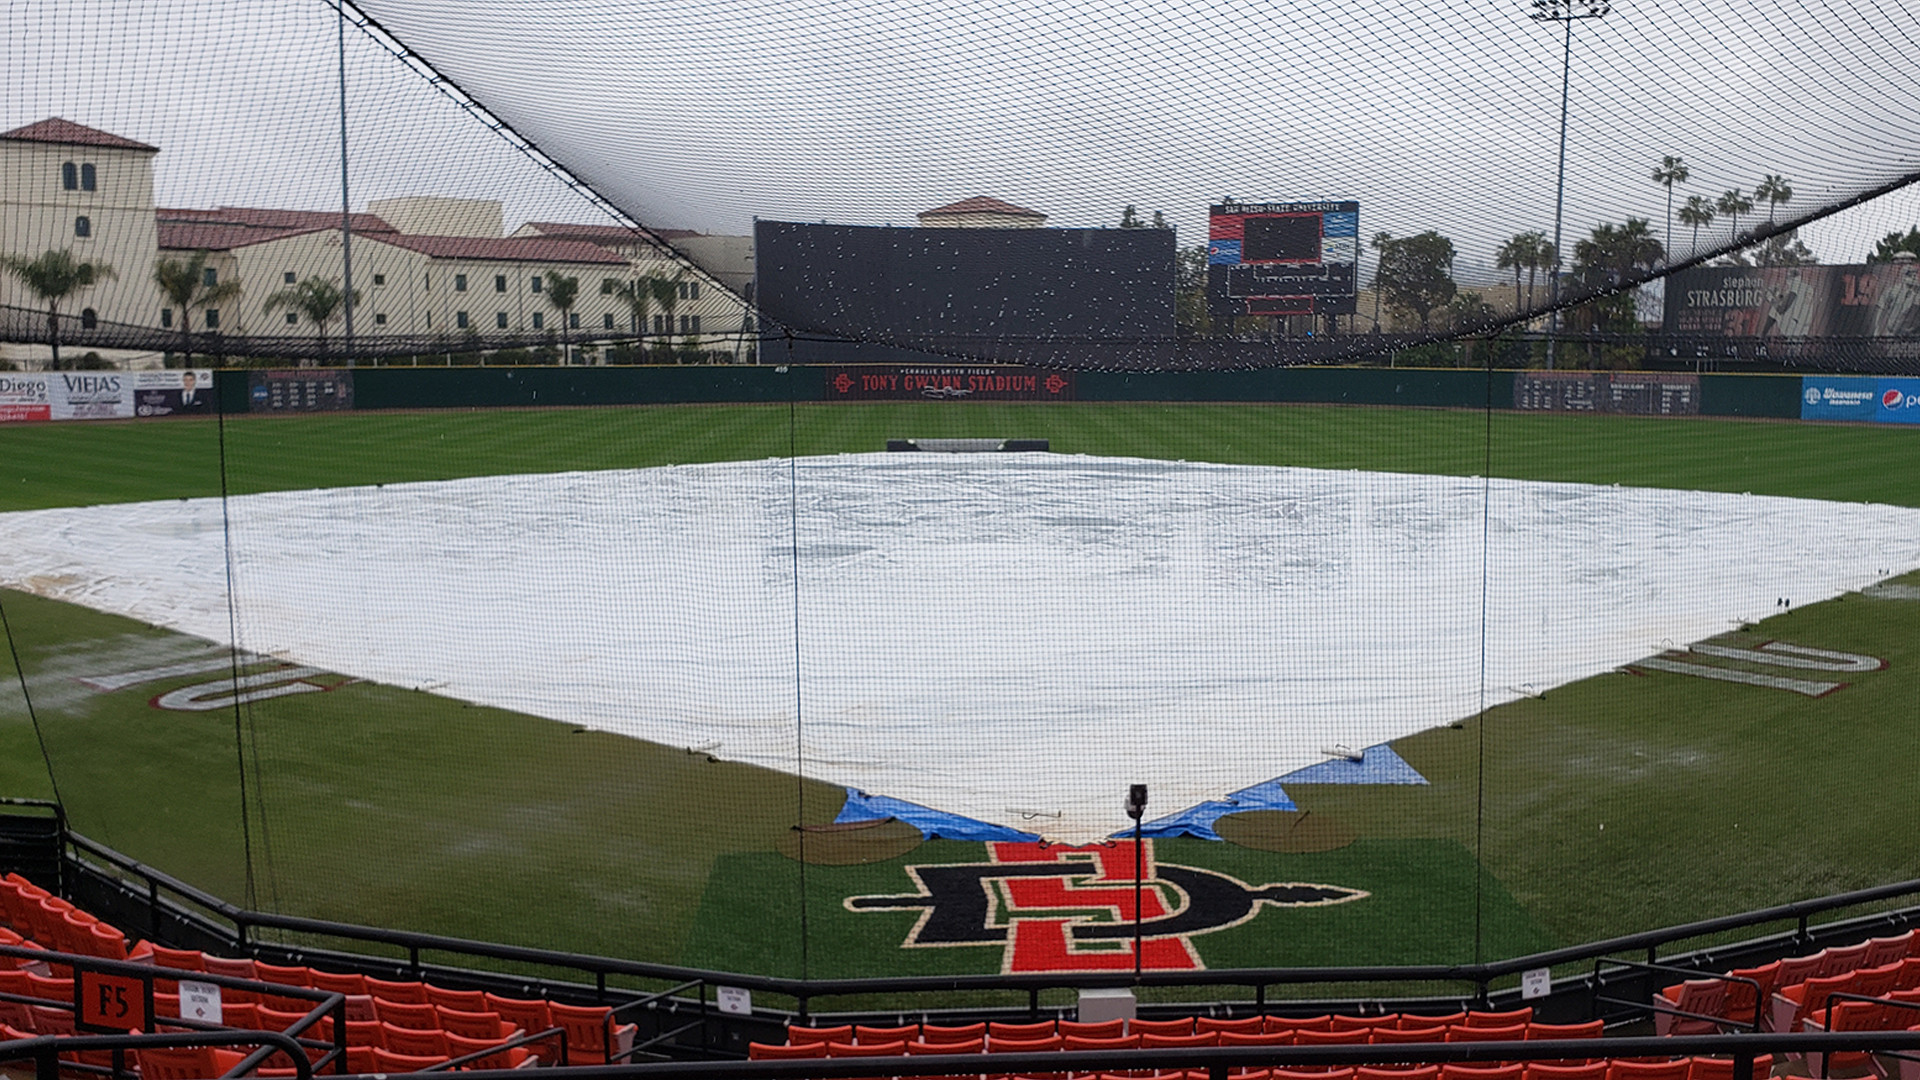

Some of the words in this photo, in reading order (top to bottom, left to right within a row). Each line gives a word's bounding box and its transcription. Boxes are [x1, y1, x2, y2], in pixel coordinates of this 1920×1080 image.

[1687, 289, 1764, 308] STRASBURG
[1841, 273, 1880, 306] 19
[0, 378, 47, 397] Diego
[63, 373, 121, 394] VIEJAS
[862, 375, 899, 391] TONY
[904, 375, 962, 391] GWYNN
[968, 375, 1037, 391] STADIUM
[98, 983, 130, 1019] F5
